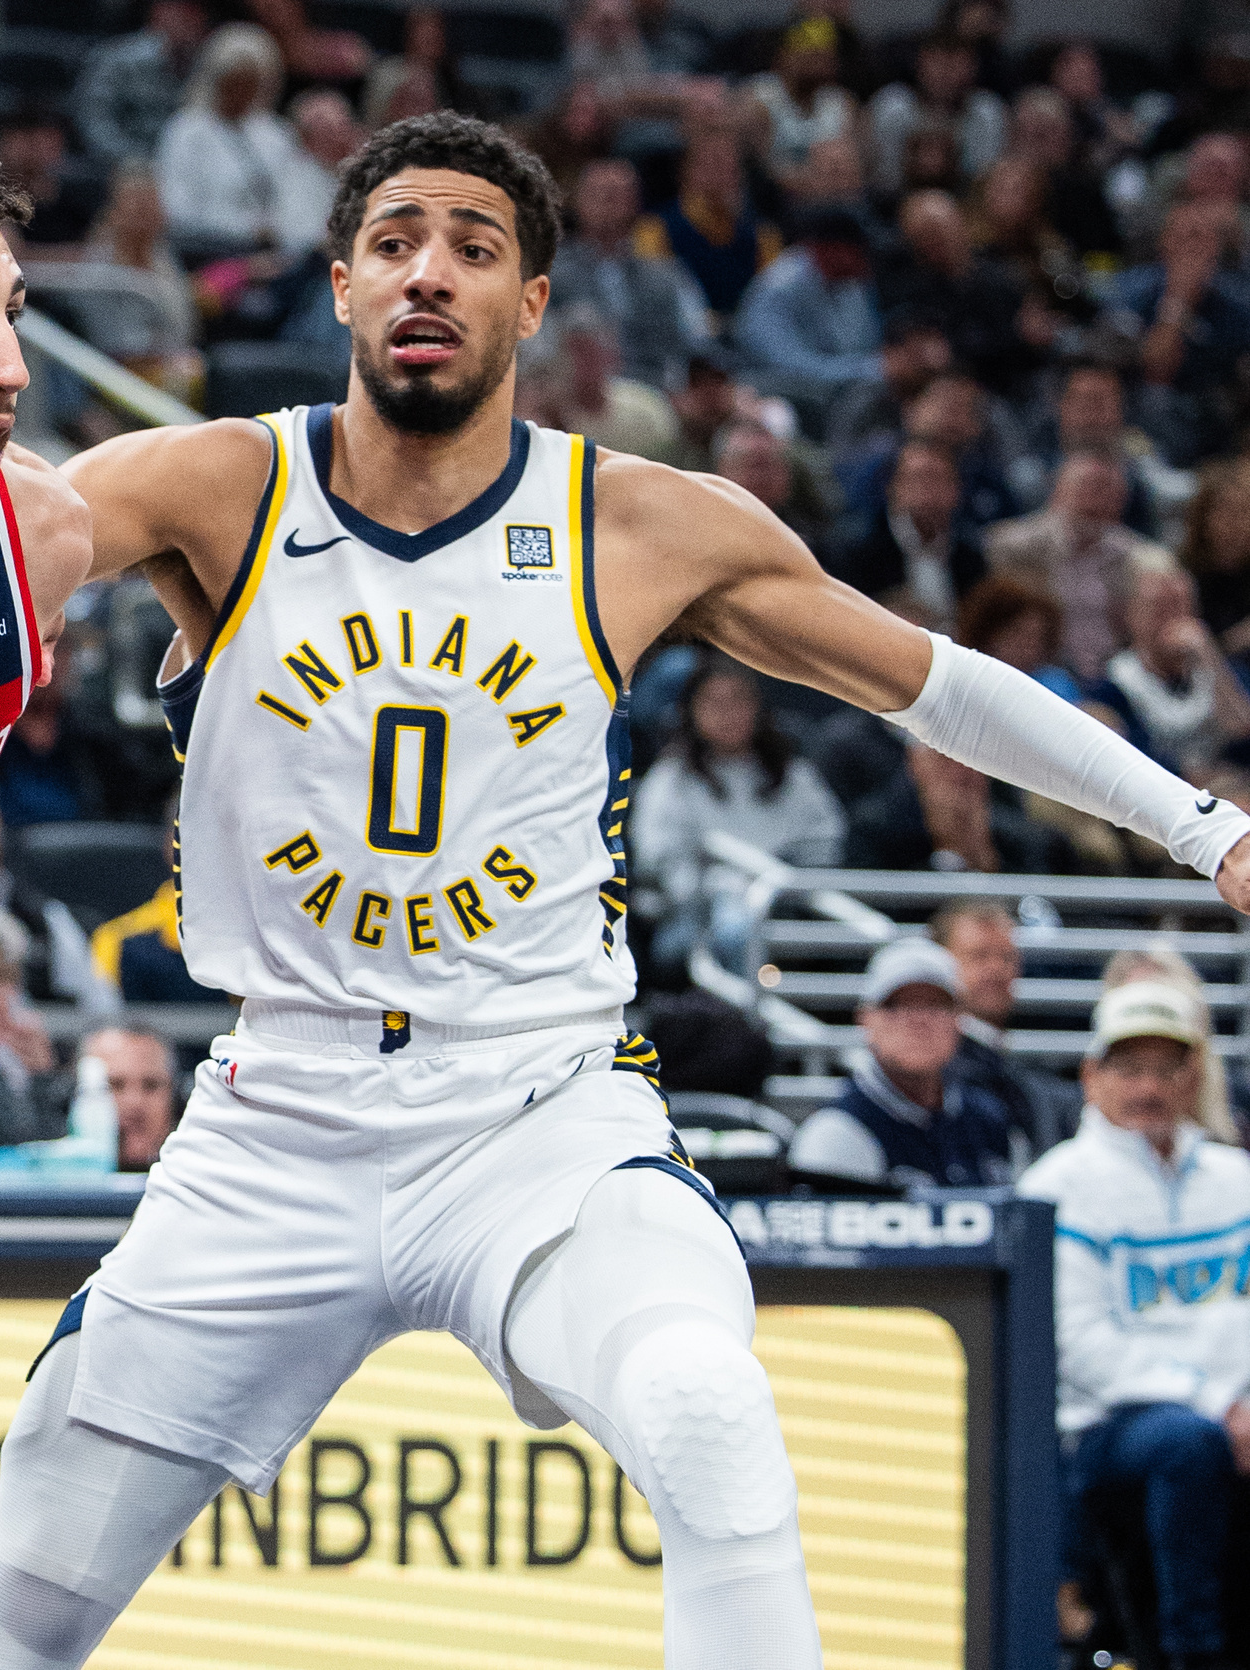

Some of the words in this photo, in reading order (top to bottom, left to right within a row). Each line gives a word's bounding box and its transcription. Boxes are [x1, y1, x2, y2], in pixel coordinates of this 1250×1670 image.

[501, 570, 563, 582] spokenote
[255, 609, 567, 749] INDIANA
[365, 702, 450, 858] 0
[262, 844, 538, 956] PACERS
[828, 1200, 995, 1249] BOLD
